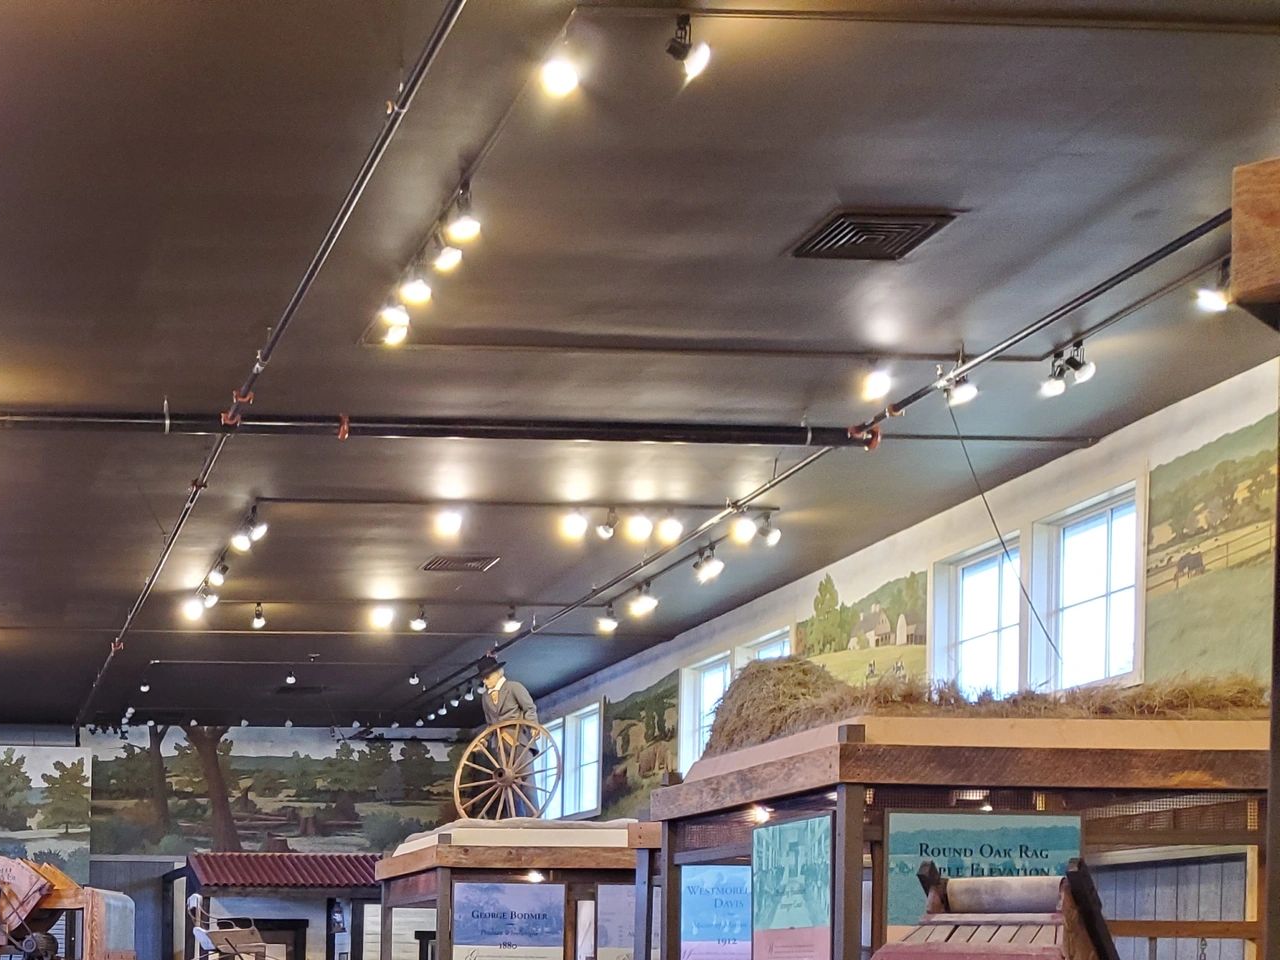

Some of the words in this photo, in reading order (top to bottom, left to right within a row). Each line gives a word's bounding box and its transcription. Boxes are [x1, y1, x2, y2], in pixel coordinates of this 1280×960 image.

[919, 842, 973, 858] ROUND
[979, 843, 1013, 859] OAK
[1019, 844, 1049, 859] RAG
[938, 866, 963, 877] PLE
[970, 863, 1050, 877] ELEVATION
[714, 898, 744, 909] DAVIS
[471, 910, 507, 919] GEORGE
[510, 911, 548, 920] BODMER
[499, 941, 517, 950] 1880
[717, 938, 738, 946] 1912
